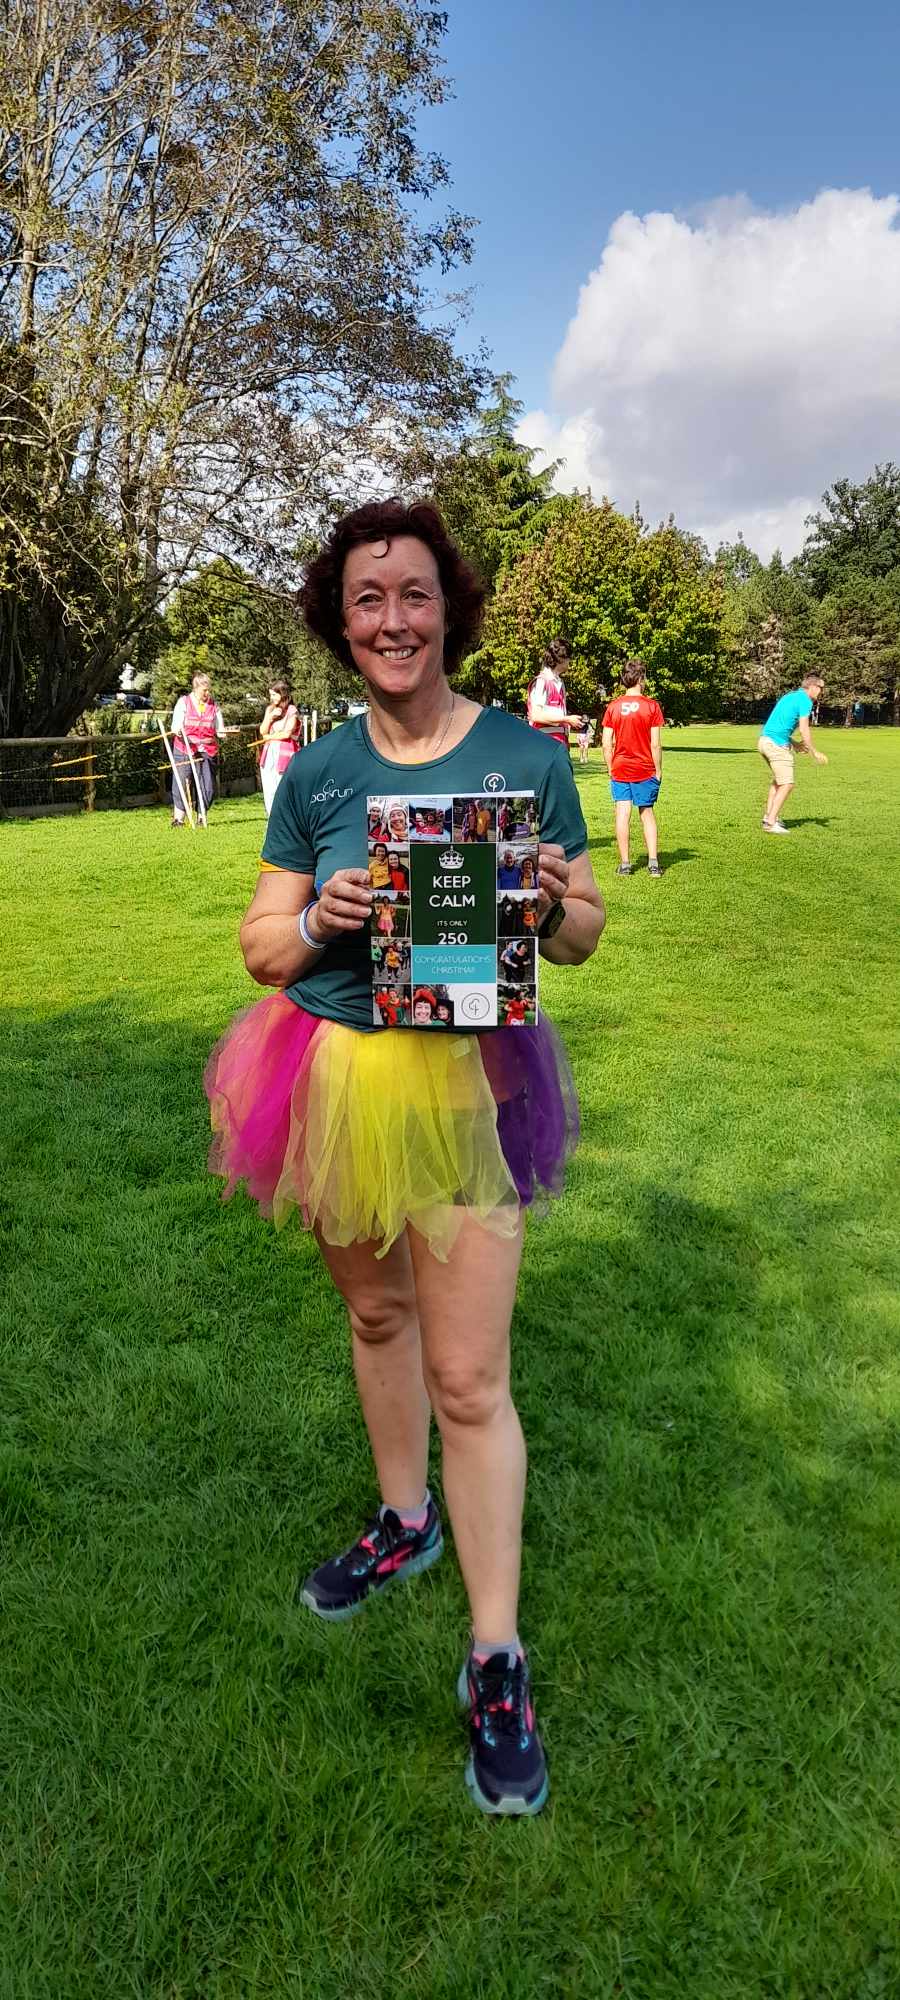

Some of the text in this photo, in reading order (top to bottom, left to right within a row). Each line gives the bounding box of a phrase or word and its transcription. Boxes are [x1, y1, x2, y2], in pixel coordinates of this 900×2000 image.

[621, 702, 640, 716] 50
[433, 875, 471, 888] KEEP
[429, 894, 476, 908] CALM
[438, 932, 468, 945] 250
